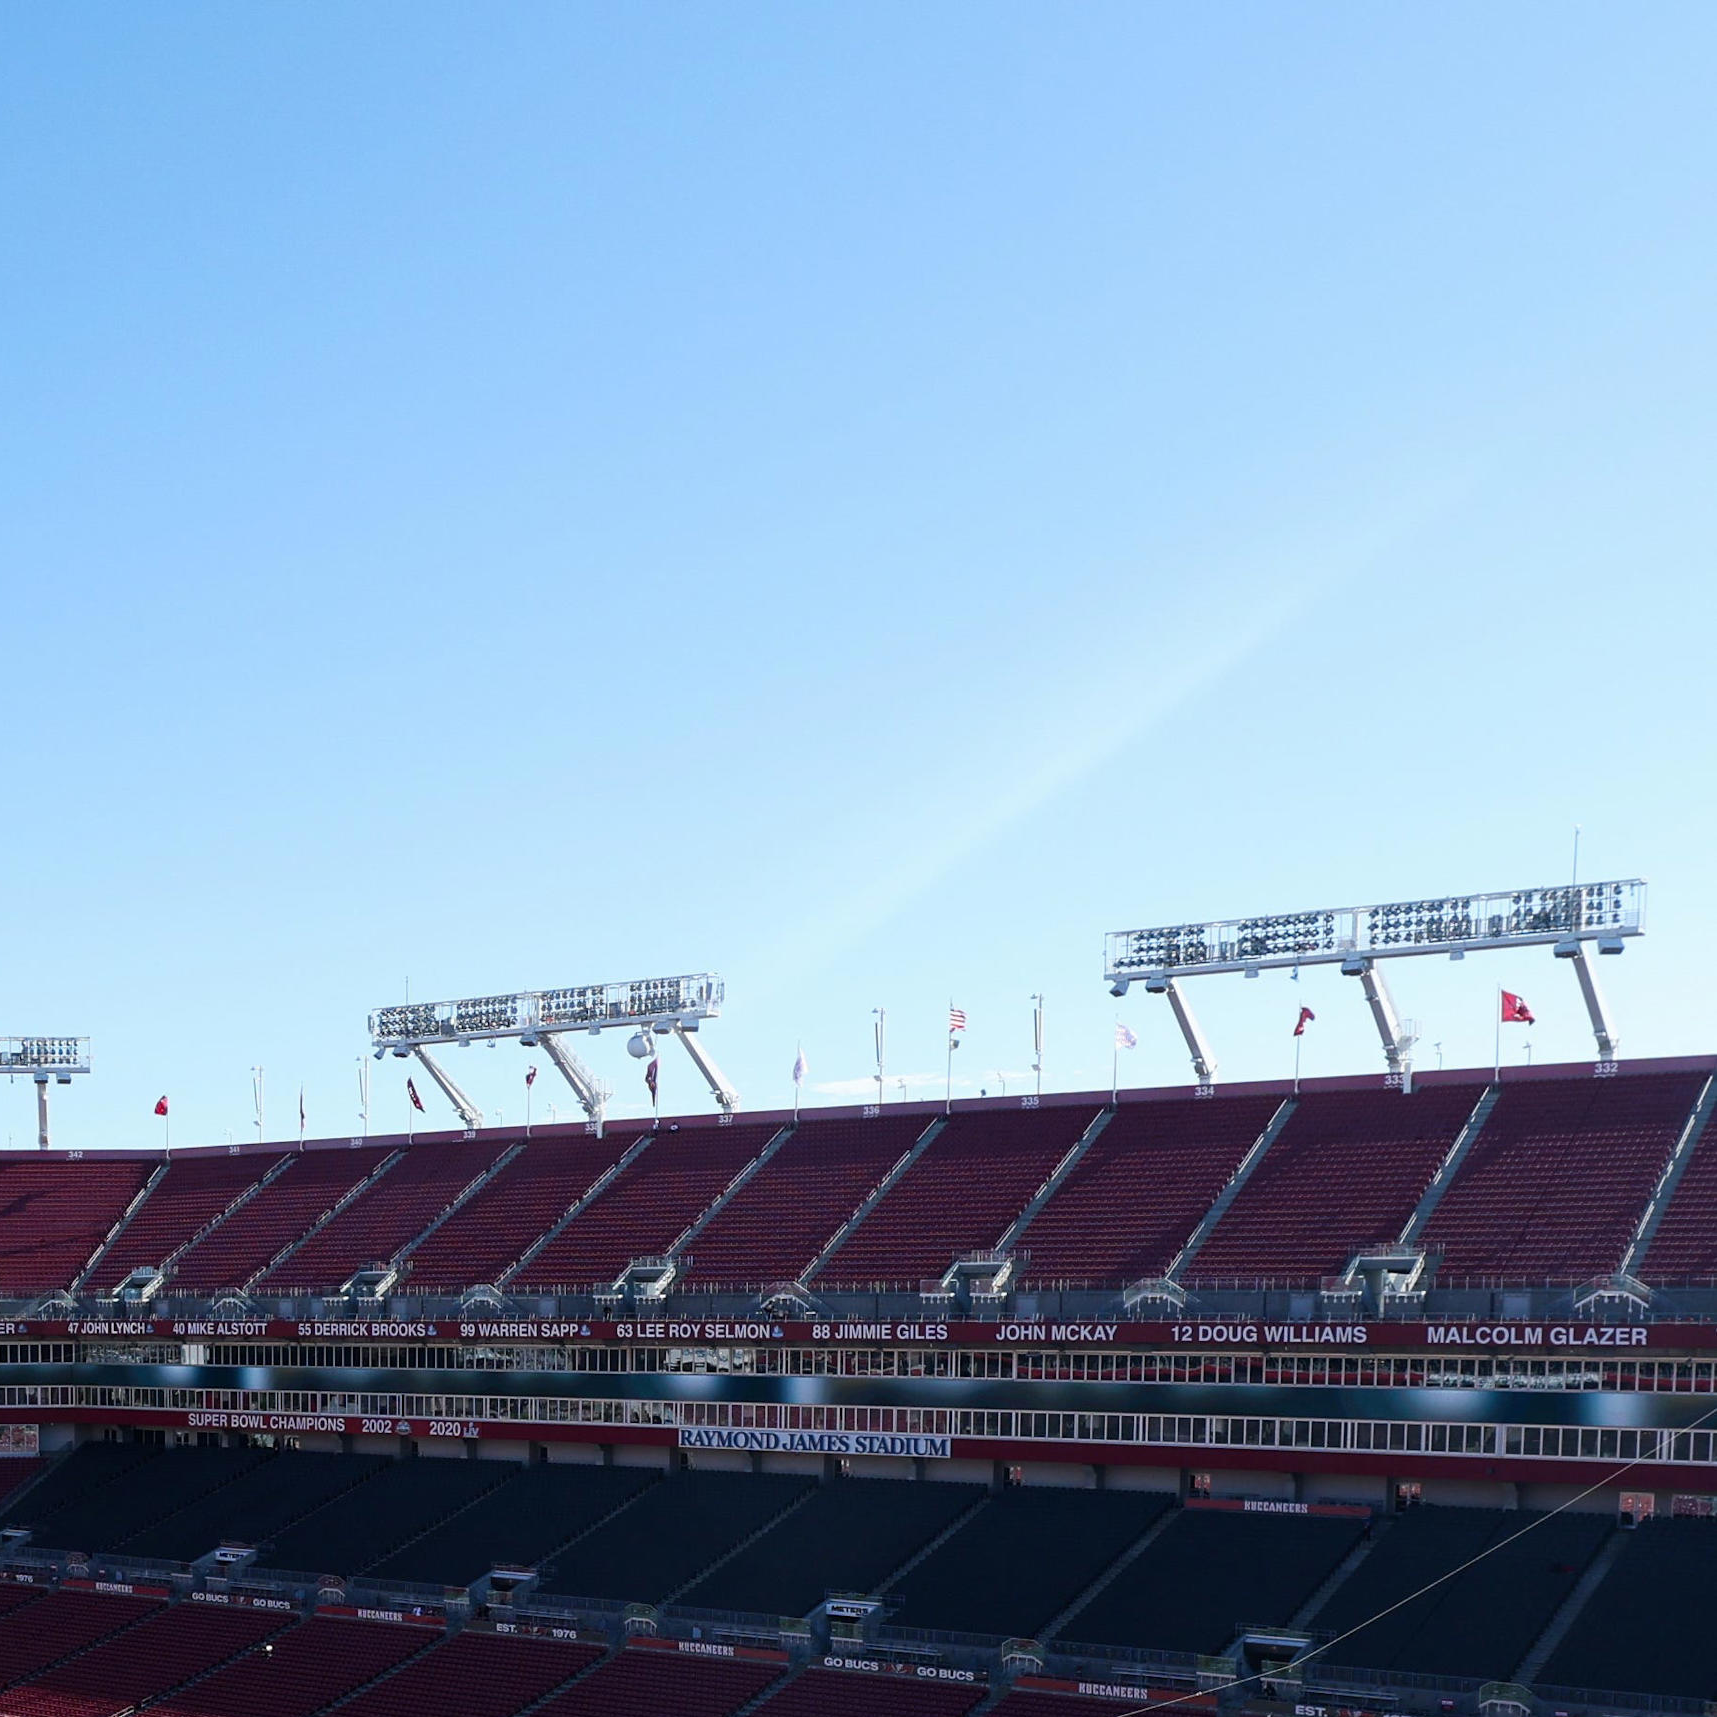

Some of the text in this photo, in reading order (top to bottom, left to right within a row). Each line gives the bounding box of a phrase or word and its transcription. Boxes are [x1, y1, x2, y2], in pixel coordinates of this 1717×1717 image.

[1595, 1062, 1618, 1074] 332
[1194, 1086, 1214, 1096] 334
[1022, 1097, 1039, 1107] 335
[863, 1106, 880, 1115] 336
[718, 1115, 734, 1124] 337
[68, 1322, 146, 1335] 47 JOHN LYNCH
[173, 1322, 267, 1336] 40 MIKE ALSTOTT
[298, 1322, 426, 1338] 55 DERRICK BROOKS
[460, 1323, 579, 1338] 99 WARREN SAPP
[616, 1323, 771, 1340] 63 LEE ROY SELMON
[812, 1324, 948, 1341] 88 JIMMIE GILES
[995, 1325, 1118, 1341] JOHN MCKAY
[1171, 1325, 1368, 1344] 12 DOUG WILLIAMS
[1427, 1326, 1648, 1346] MALCOLM GLAZER
[188, 1412, 393, 1434] SUPER BOWL CHAMPIONS 2002
[429, 1420, 461, 1437] 2020
[680, 1429, 949, 1457] RAYMOND JAMES STADIUM
[1244, 1500, 1308, 1514] BUCCANEERS
[191, 1592, 229, 1603] GO BUCS
[253, 1598, 291, 1610] GO BUCS
[357, 1608, 403, 1622] BUCCANEERS
[496, 1623, 577, 1640] EST. 1976
[678, 1641, 735, 1657] BUCCANEERS
[824, 1657, 879, 1672] GO BUCS
[917, 1666, 975, 1682] GO BUCS
[1078, 1682, 1148, 1700] BUCCANEERS
[1295, 1705, 1328, 1717] EST.
